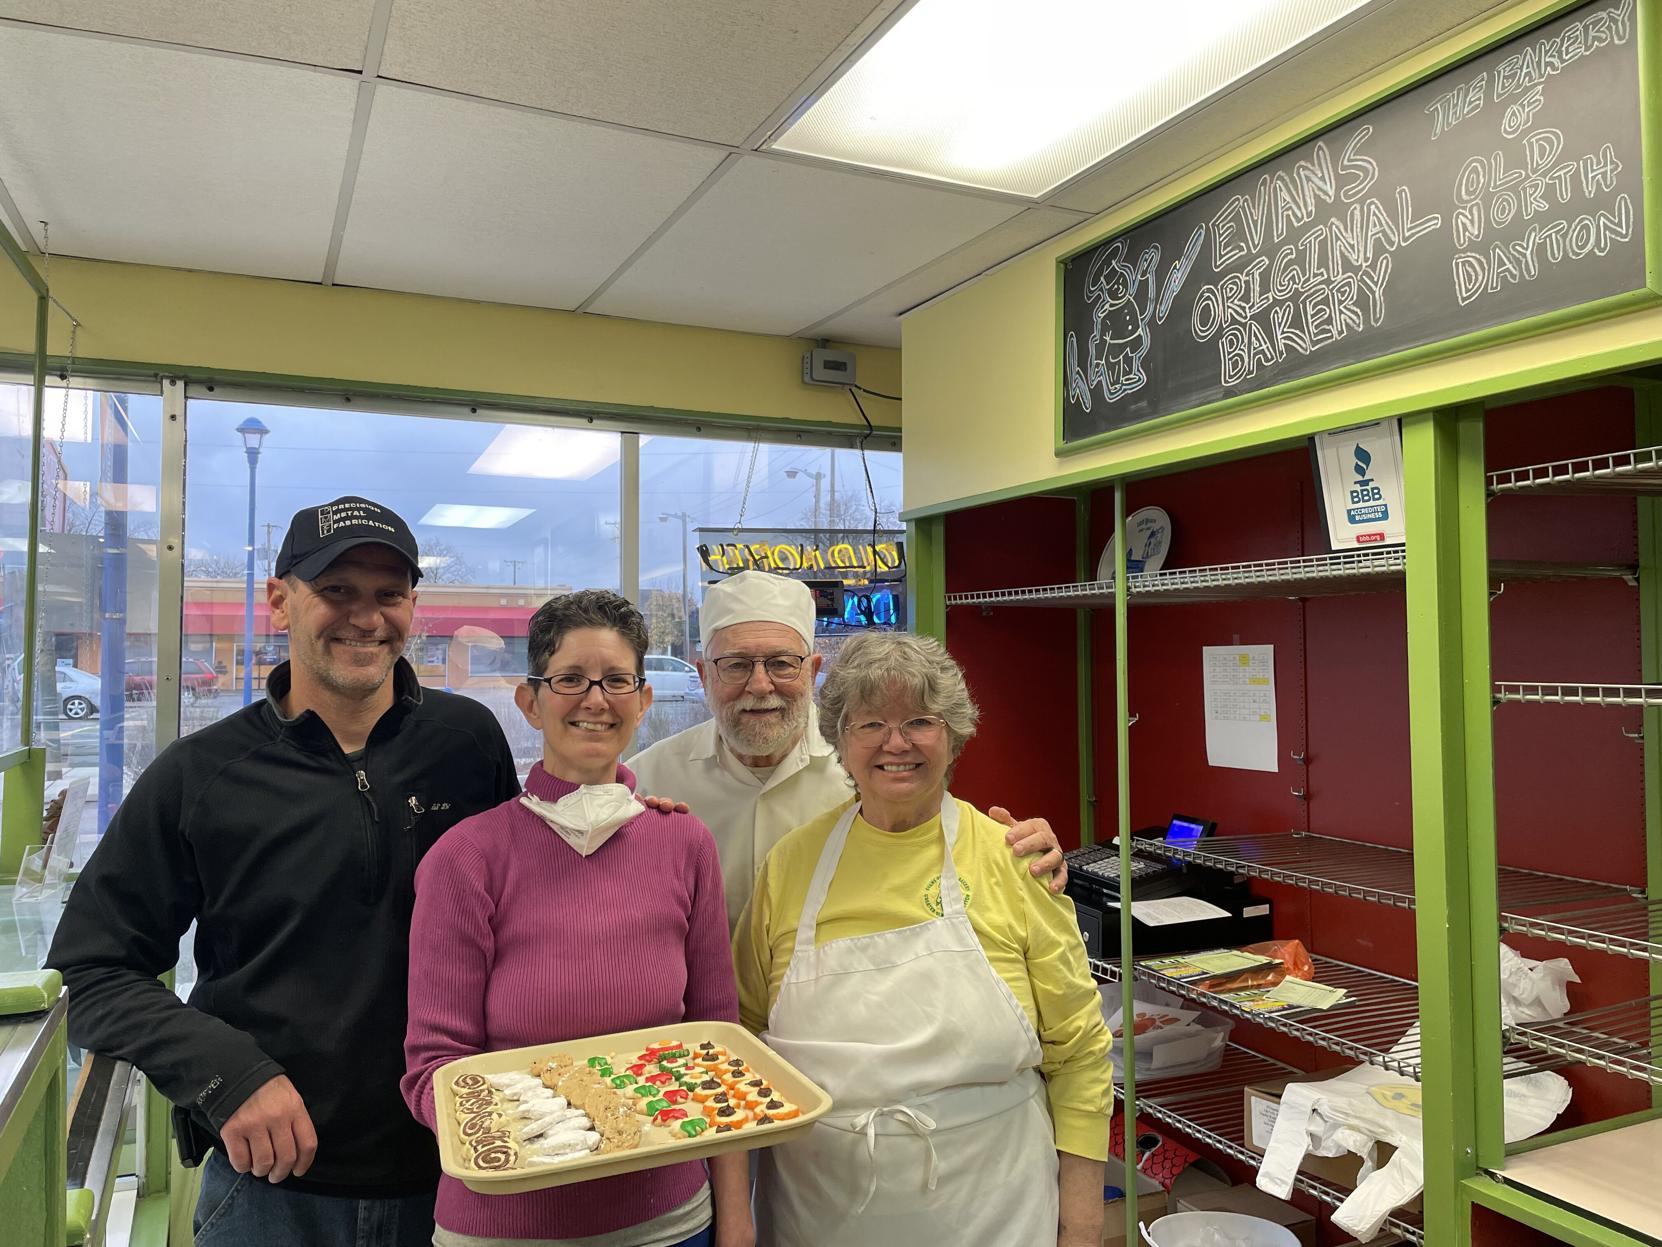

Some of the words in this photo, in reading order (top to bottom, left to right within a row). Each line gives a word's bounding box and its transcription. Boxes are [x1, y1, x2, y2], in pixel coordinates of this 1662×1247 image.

[1425, 72, 1487, 140] THE
[1494, 0, 1633, 102] BAKERY
[1501, 84, 1544, 138] OF
[1453, 128, 1563, 206] OLD
[1209, 125, 1378, 271] EVANS
[1453, 143, 1622, 249] NORTH
[1192, 186, 1441, 342] ORIGINAL
[1453, 194, 1633, 306] DAYTON
[1219, 253, 1392, 386] BAKERY
[332, 503, 381, 513] PRECISION
[333, 510, 367, 521] METAL
[1350, 486, 1382, 504] BBB
[1350, 505, 1386, 516] ACCREDITED
[1355, 512, 1383, 521] BUSINESS
[333, 519, 396, 533] FABRICATION
[1359, 534, 1381, 542] bbb.org
